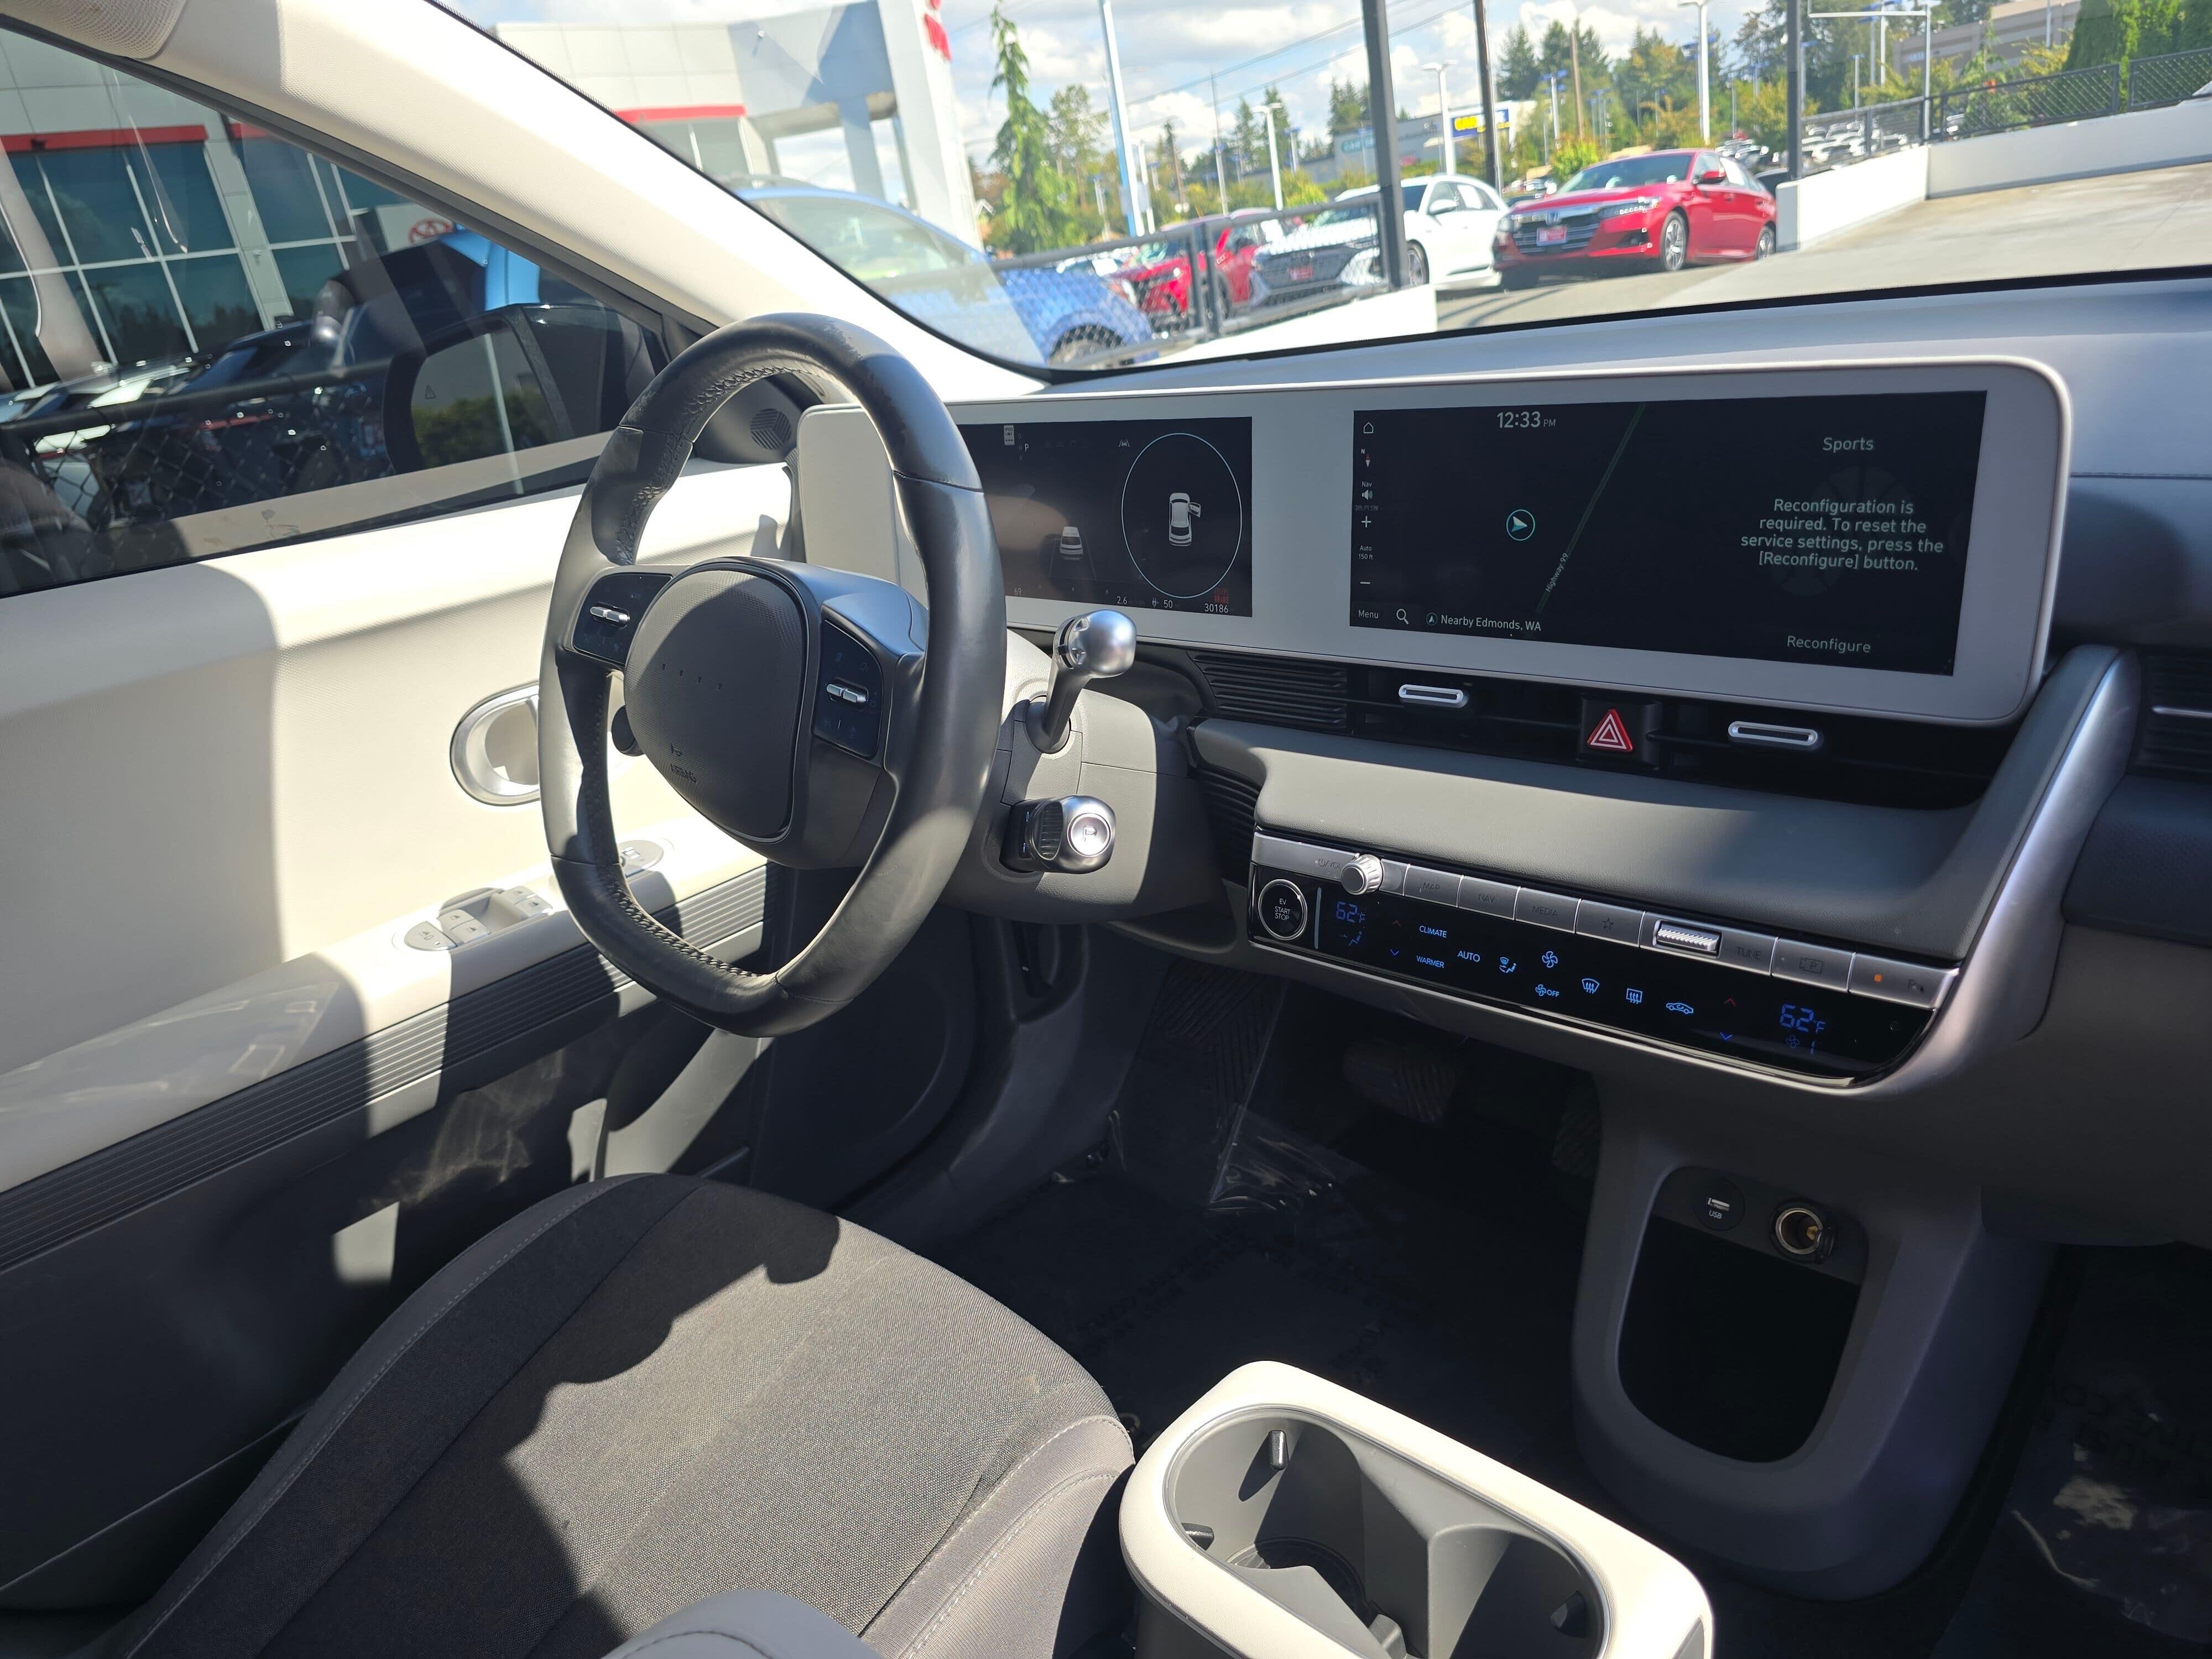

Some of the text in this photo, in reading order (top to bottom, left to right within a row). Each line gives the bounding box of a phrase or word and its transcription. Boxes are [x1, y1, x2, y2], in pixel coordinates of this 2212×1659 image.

[1497, 411, 1556, 428] 12:33 PM
[1025, 444, 1029, 452] P
[1823, 436, 1874, 453] Sports
[1773, 498, 1914, 515] Reconfiguration is
[1759, 517, 1927, 533] required. To reset the
[1741, 534, 1944, 554] service settings, press the
[1759, 551, 1918, 571] [Reconfigure] button.
[1545, 552, 1568, 593] Highway 99
[1117, 596, 1128, 604] 2.6
[1164, 599, 1173, 608] 50
[1204, 603, 1229, 613] 30186
[1358, 609, 1379, 618] Menu
[1441, 615, 1541, 631] Nearby Edmonds, WA
[1787, 635, 1871, 655] Reconfigure
[1423, 882, 1441, 891] MAP
[1478, 894, 1495, 903] NAV
[1274, 906, 1291, 915] START
[1274, 912, 1290, 921] STOP
[1532, 906, 1558, 917] MEDIA
[1419, 925, 1447, 938] CLIMATE
[1457, 950, 1480, 962] AUTO
[1737, 947, 1761, 959] TUNE
[1416, 955, 1444, 968] WARMER
[1709, 1209, 1722, 1219] USB
